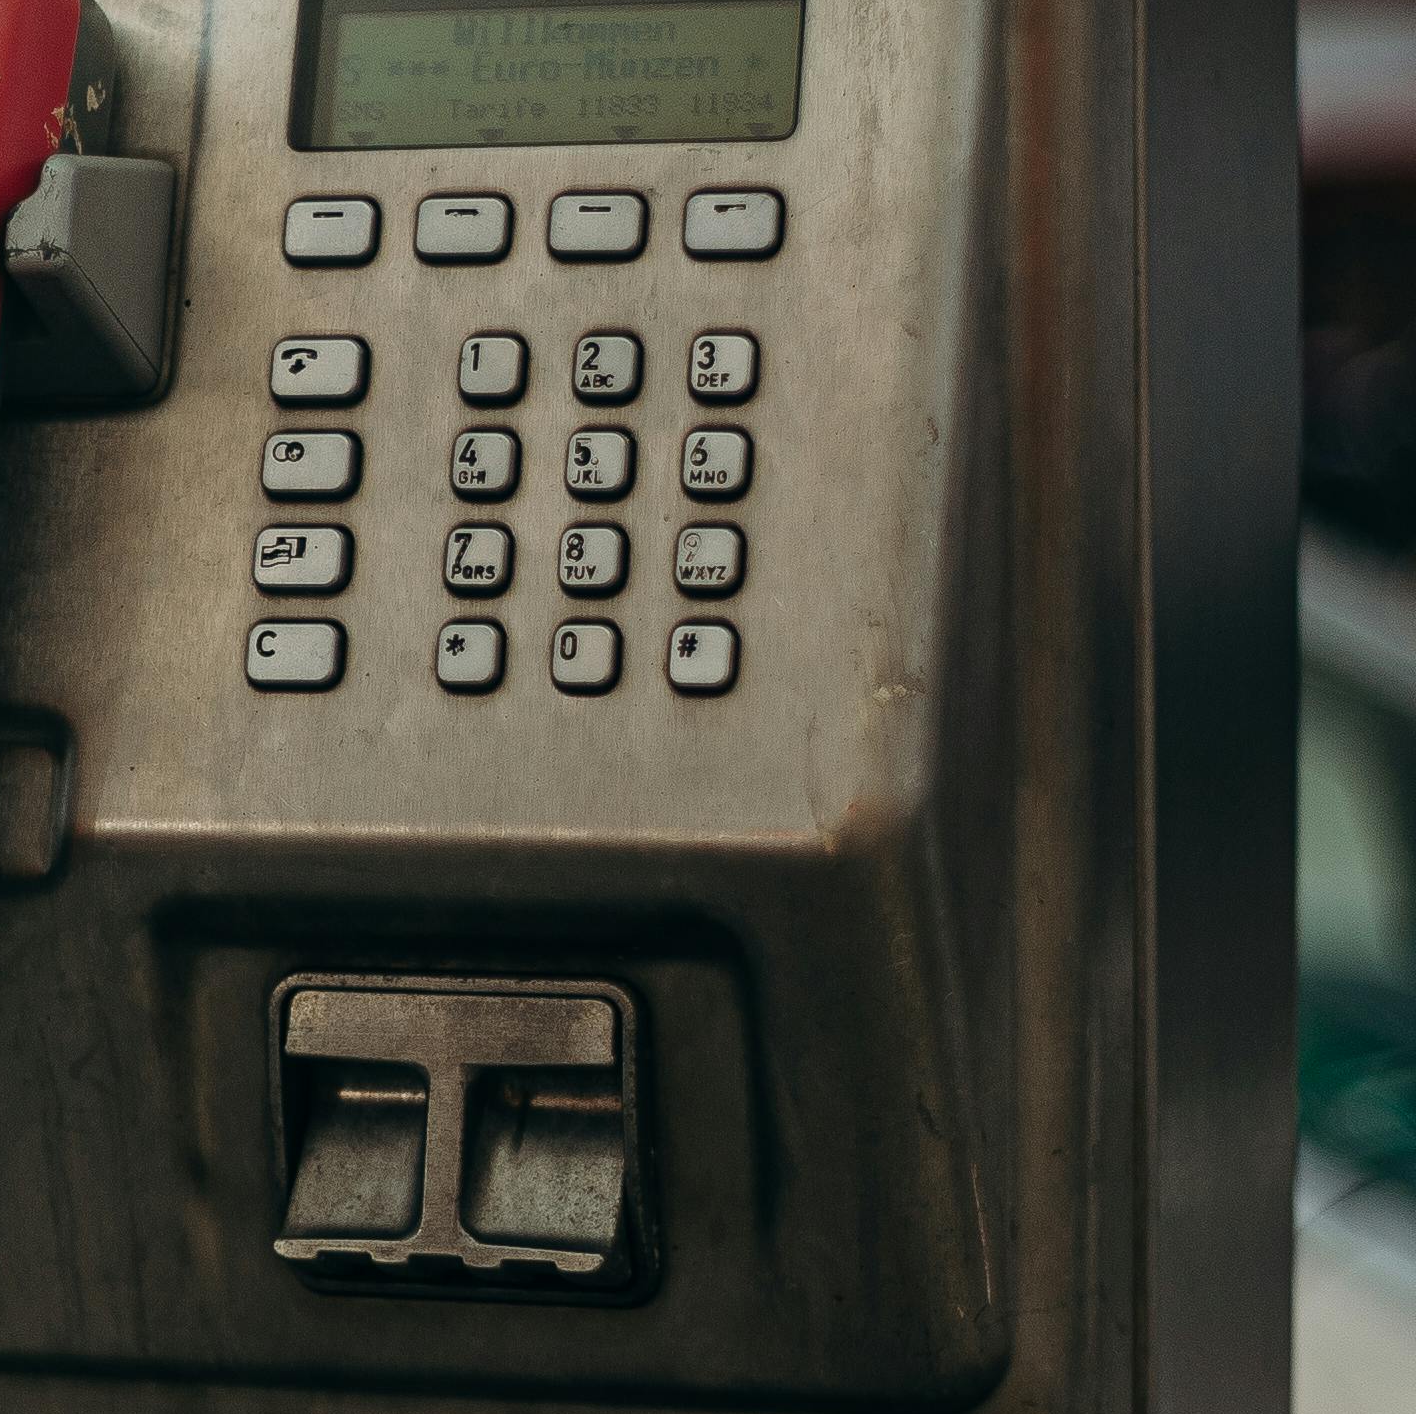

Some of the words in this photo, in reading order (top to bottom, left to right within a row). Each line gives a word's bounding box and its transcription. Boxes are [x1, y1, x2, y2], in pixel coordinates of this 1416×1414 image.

[445, 97, 549, 122] Tarife
[470, 343, 481, 372] 1
[581, 343, 601, 372] 2
[697, 342, 716, 370] 3
[580, 373, 614, 389] ABC
[697, 372, 731, 388] DEF
[459, 439, 477, 467] 4
[574, 438, 591, 466] 5
[690, 437, 708, 466] 6
[458, 470, 486, 485] GHI
[572, 469, 603, 485] JKL
[689, 469, 727, 484] MNO
[454, 533, 472, 565] 7
[566, 533, 584, 562] 8
[683, 532, 702, 562] 9
[451, 565, 496, 580] PQRS
[564, 565, 597, 580] TUV
[679, 565, 726, 580] WXYZ
[256, 630, 277, 658] C
